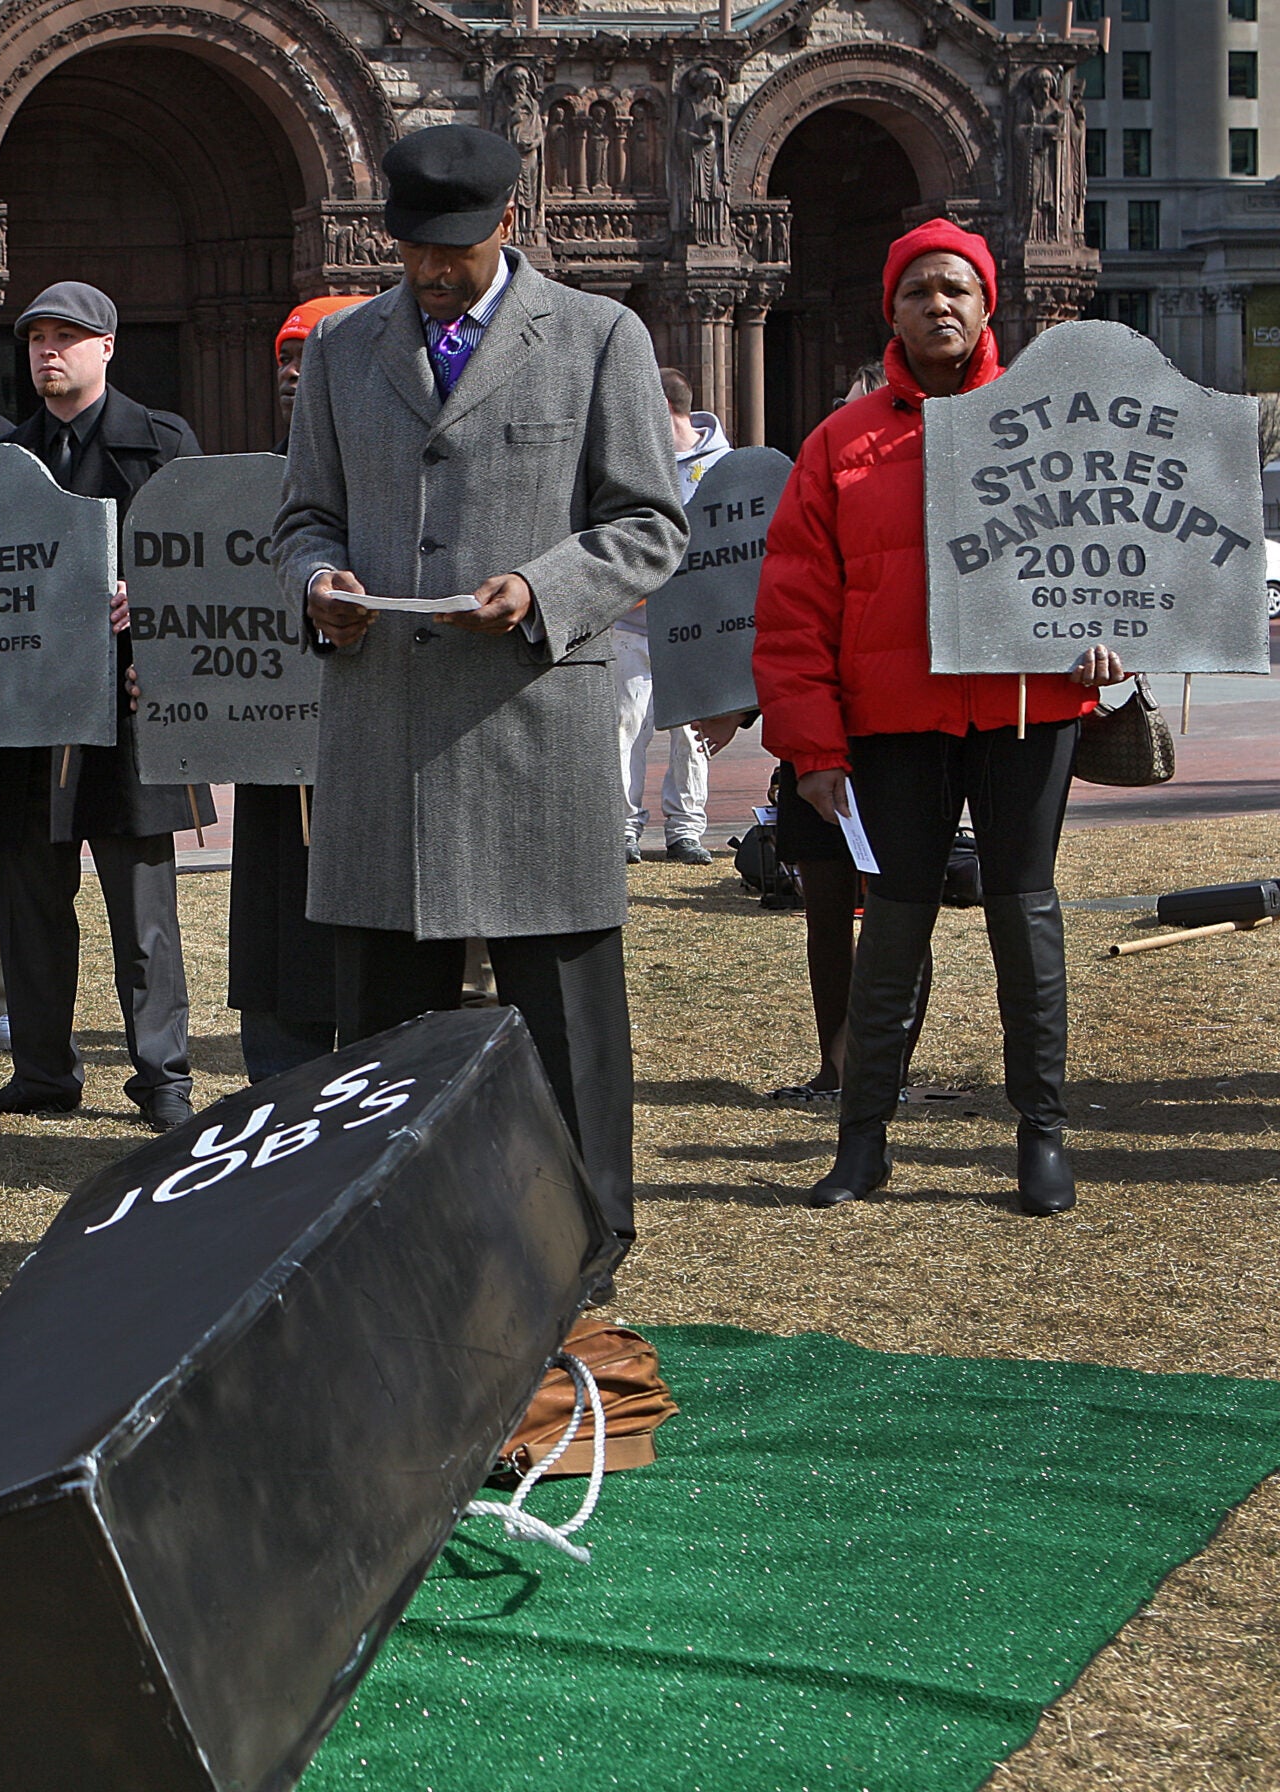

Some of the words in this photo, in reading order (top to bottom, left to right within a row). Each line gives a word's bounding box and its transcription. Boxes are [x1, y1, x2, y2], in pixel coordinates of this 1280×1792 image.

[989, 391, 1179, 449] STAGE
[971, 450, 1188, 505] STORES
[703, 497, 766, 527] THE
[133, 531, 204, 567] DDI
[946, 487, 1251, 575] BANKRUPT
[1015, 543, 1146, 580] 2000
[1031, 587, 1067, 608] 60
[1071, 588, 1176, 610] STORES
[667, 624, 702, 644] 500
[716, 615, 756, 634] JOBS
[190, 645, 283, 679] 2003
[146, 702, 209, 727] 2,100
[228, 702, 319, 722] LAYOFFS
[84, 1078, 416, 1234] JOBS
